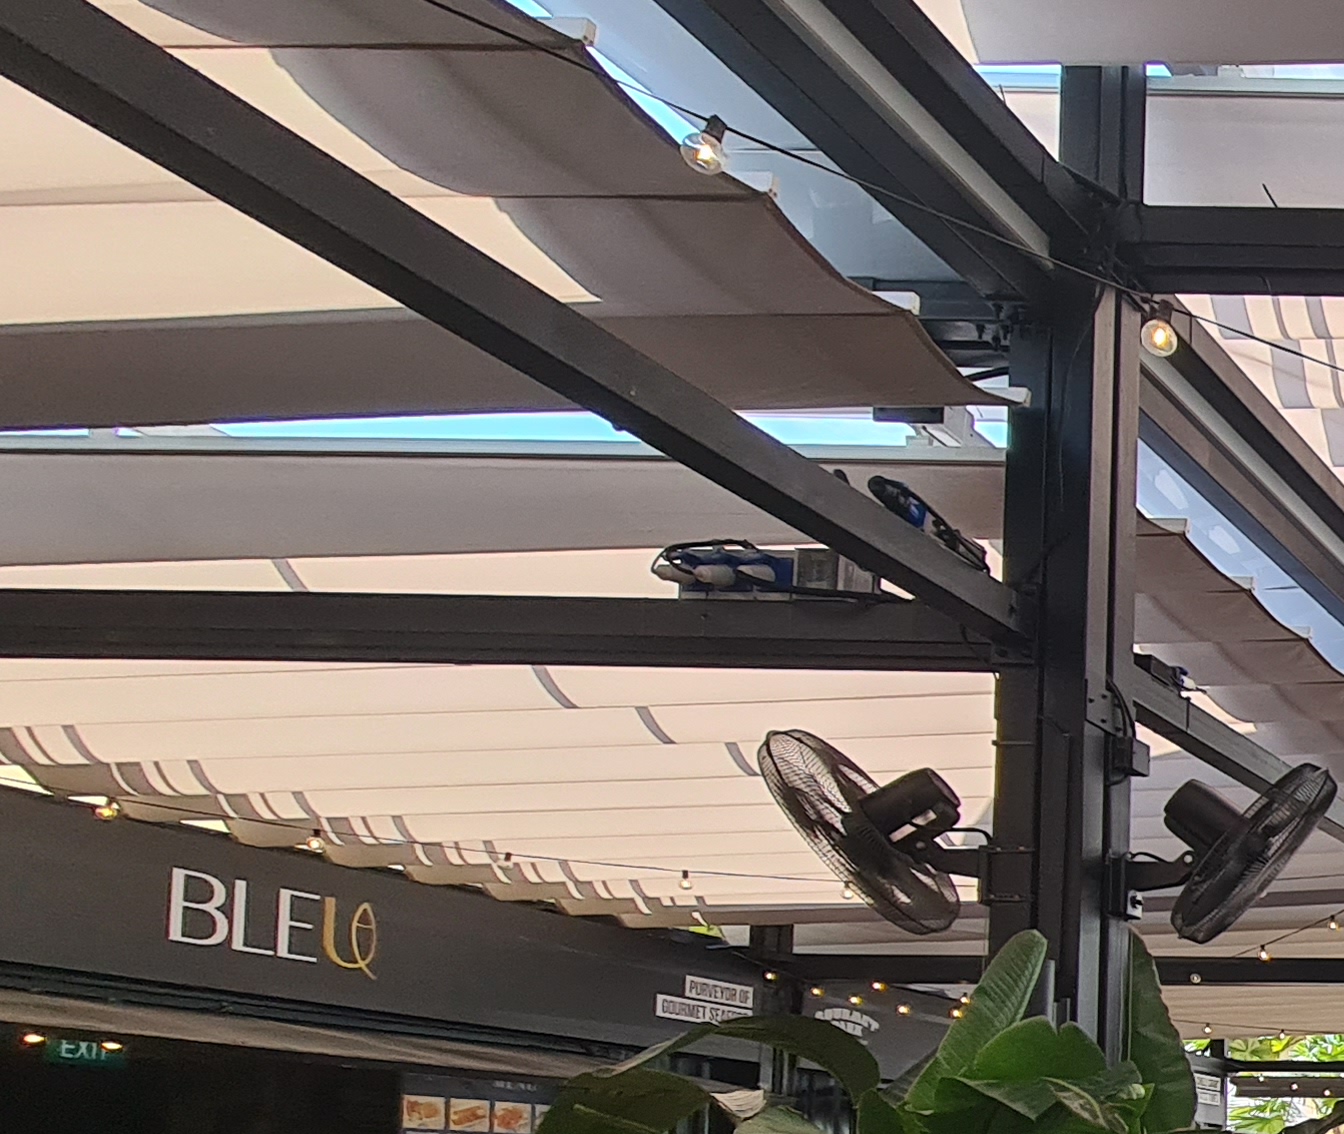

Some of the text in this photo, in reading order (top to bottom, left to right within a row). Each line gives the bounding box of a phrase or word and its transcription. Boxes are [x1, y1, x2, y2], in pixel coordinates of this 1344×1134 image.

[168, 866, 378, 981] BLEU
[690, 980, 750, 1004] PURVEYOR OF
[661, 998, 706, 1020] GOURMET
